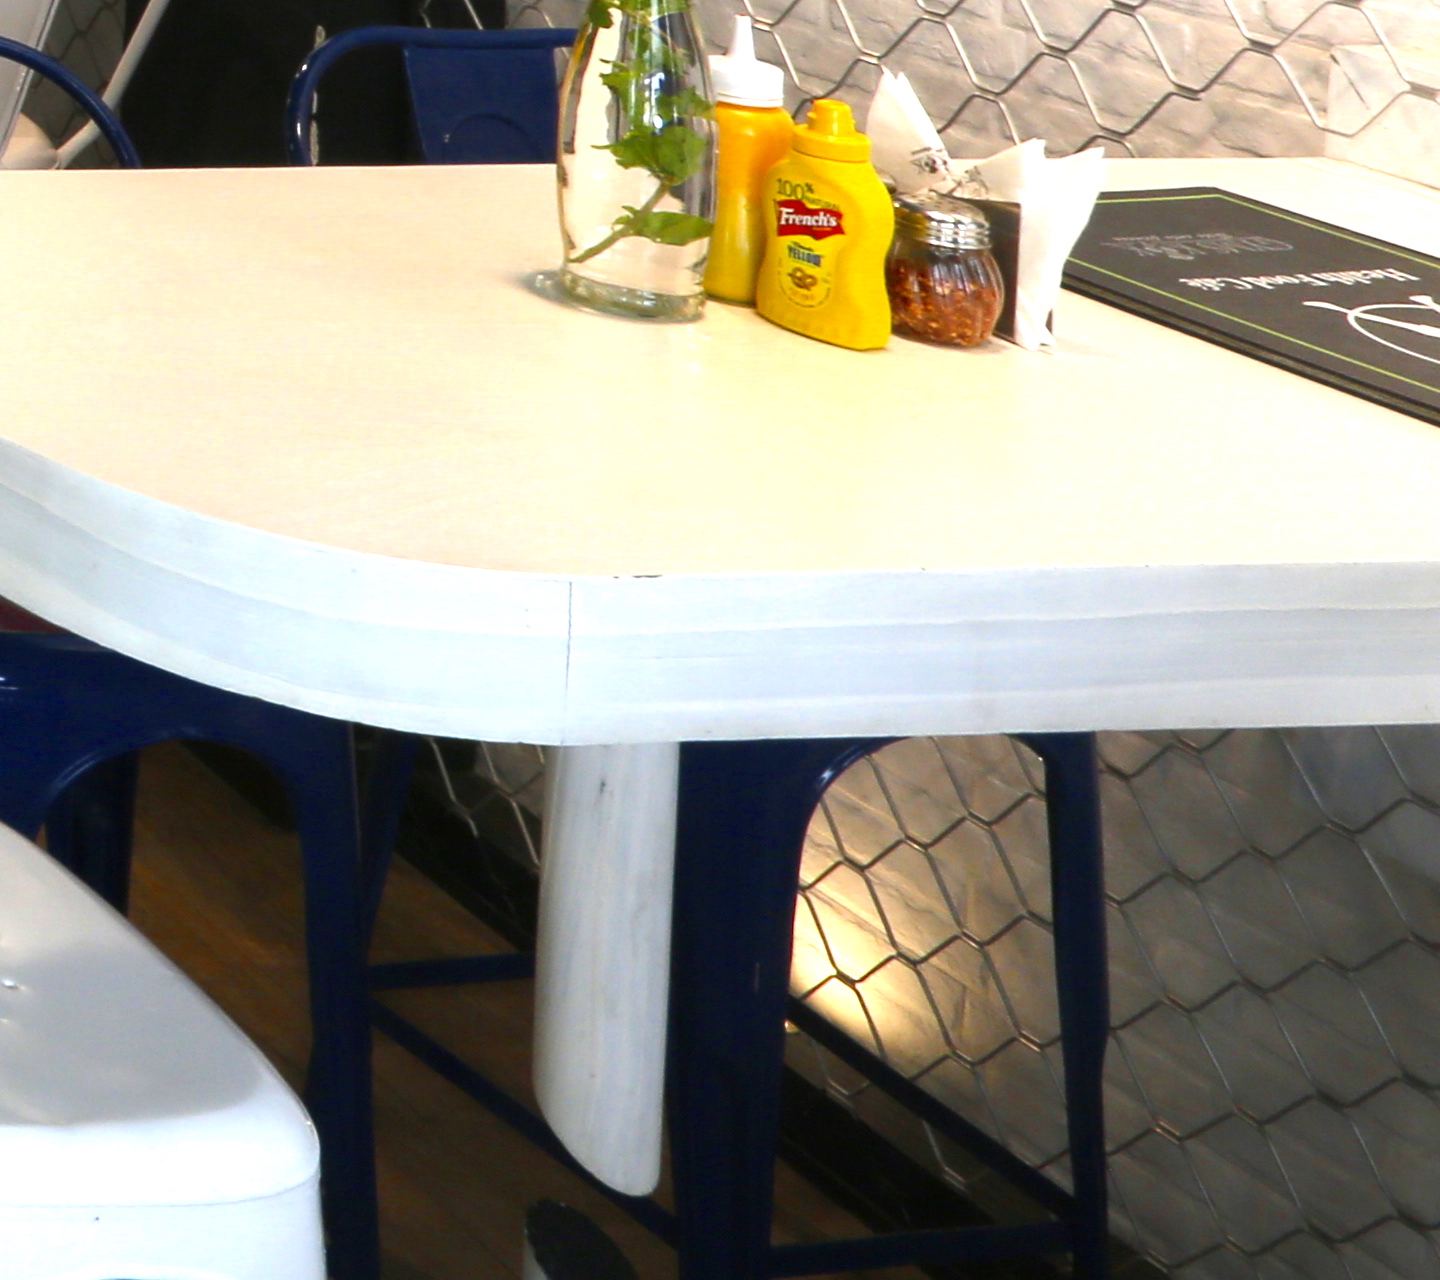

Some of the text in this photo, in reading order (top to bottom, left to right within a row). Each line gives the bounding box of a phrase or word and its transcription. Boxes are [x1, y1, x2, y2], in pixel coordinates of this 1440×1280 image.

[779, 207, 838, 227] French's
[1240, 272, 1330, 289] Food
[1318, 267, 1421, 287] Health
